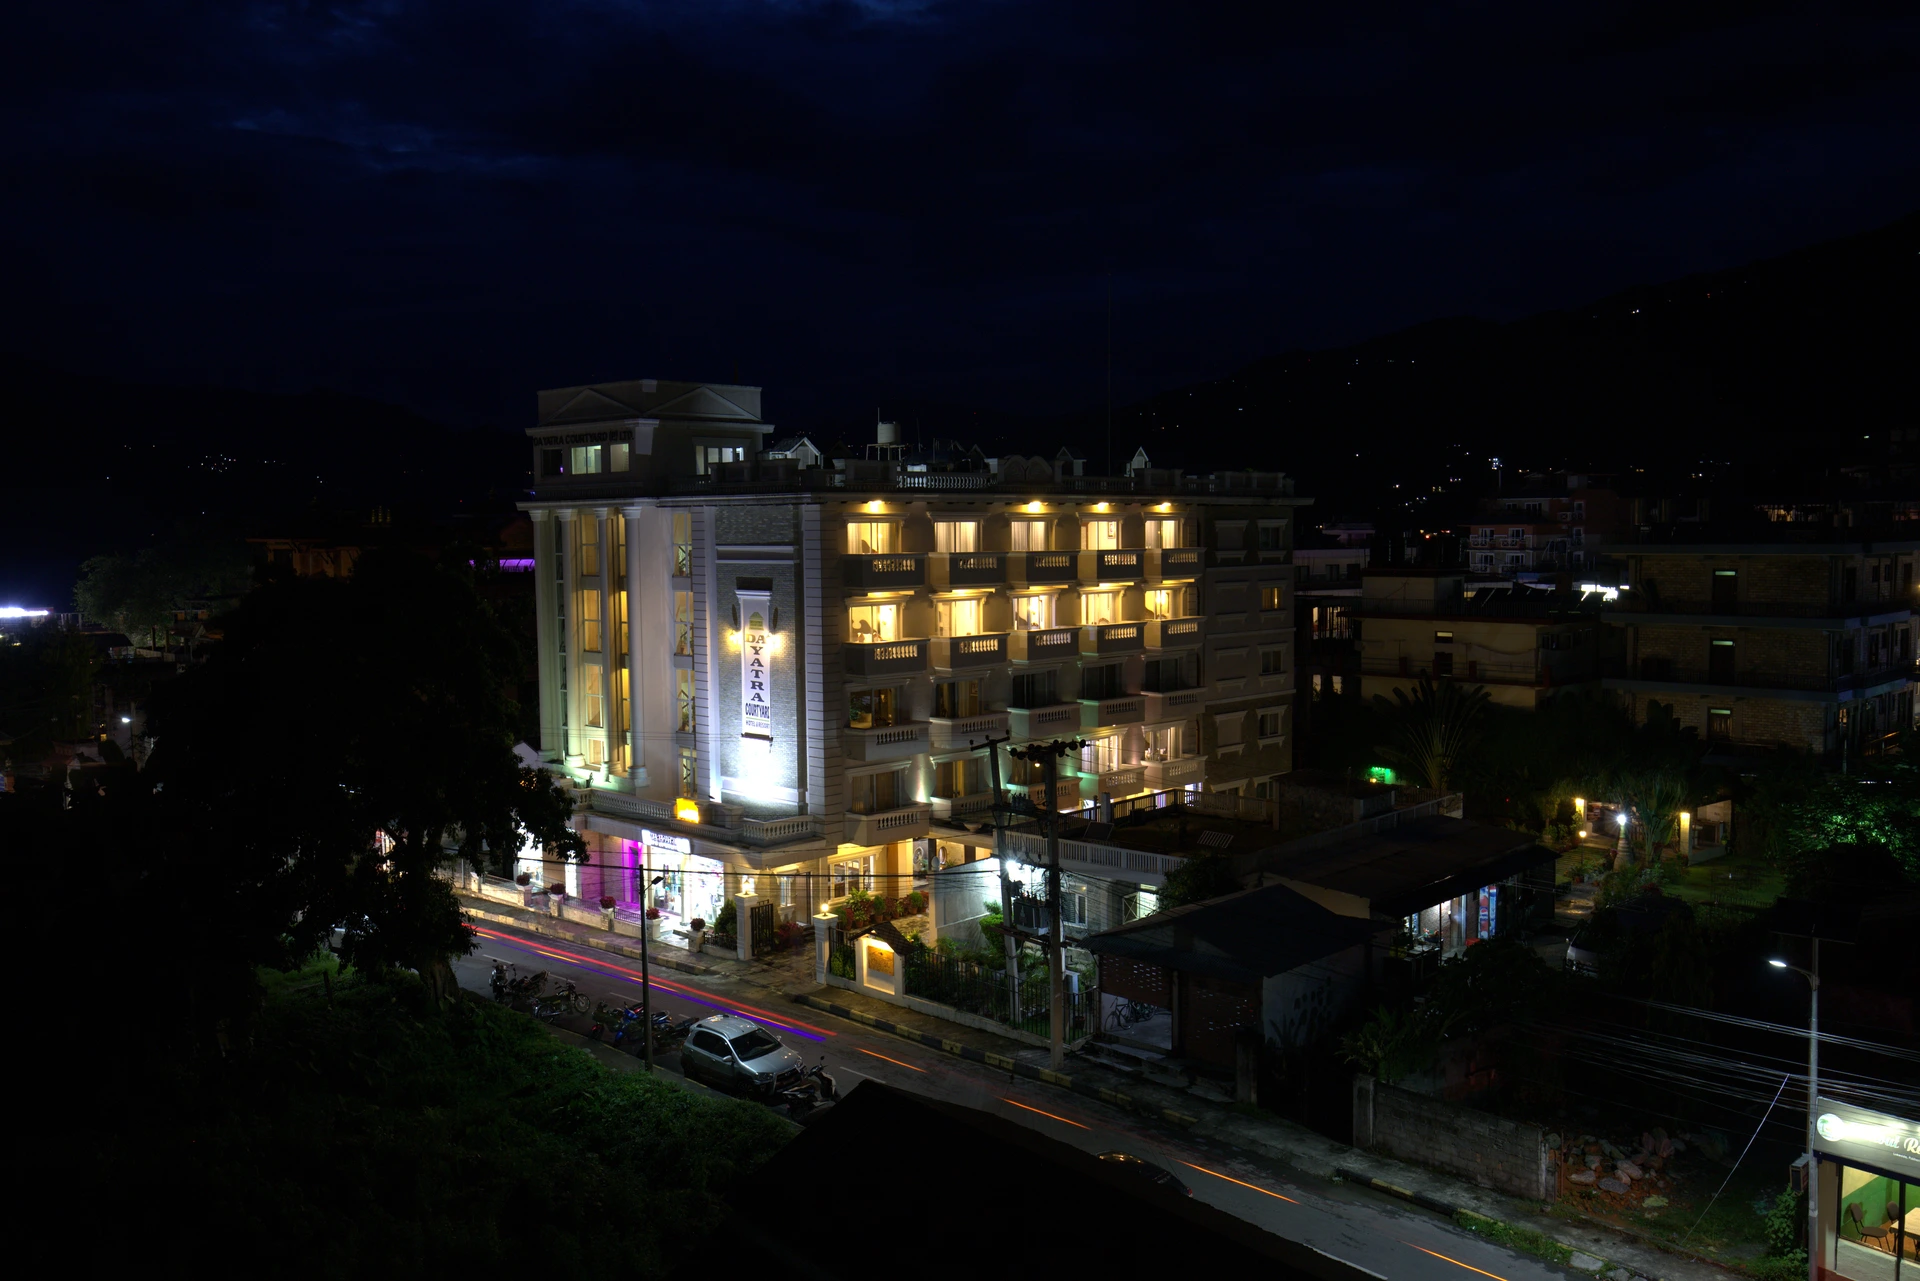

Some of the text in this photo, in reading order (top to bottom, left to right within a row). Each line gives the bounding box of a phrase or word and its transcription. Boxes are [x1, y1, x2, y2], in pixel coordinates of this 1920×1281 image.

[533, 436, 564, 446] DAYATRA
[565, 432, 608, 444] COURTYARD
[745, 634, 766, 703] DAYATRA
[745, 703, 770, 719] COURTYARD
